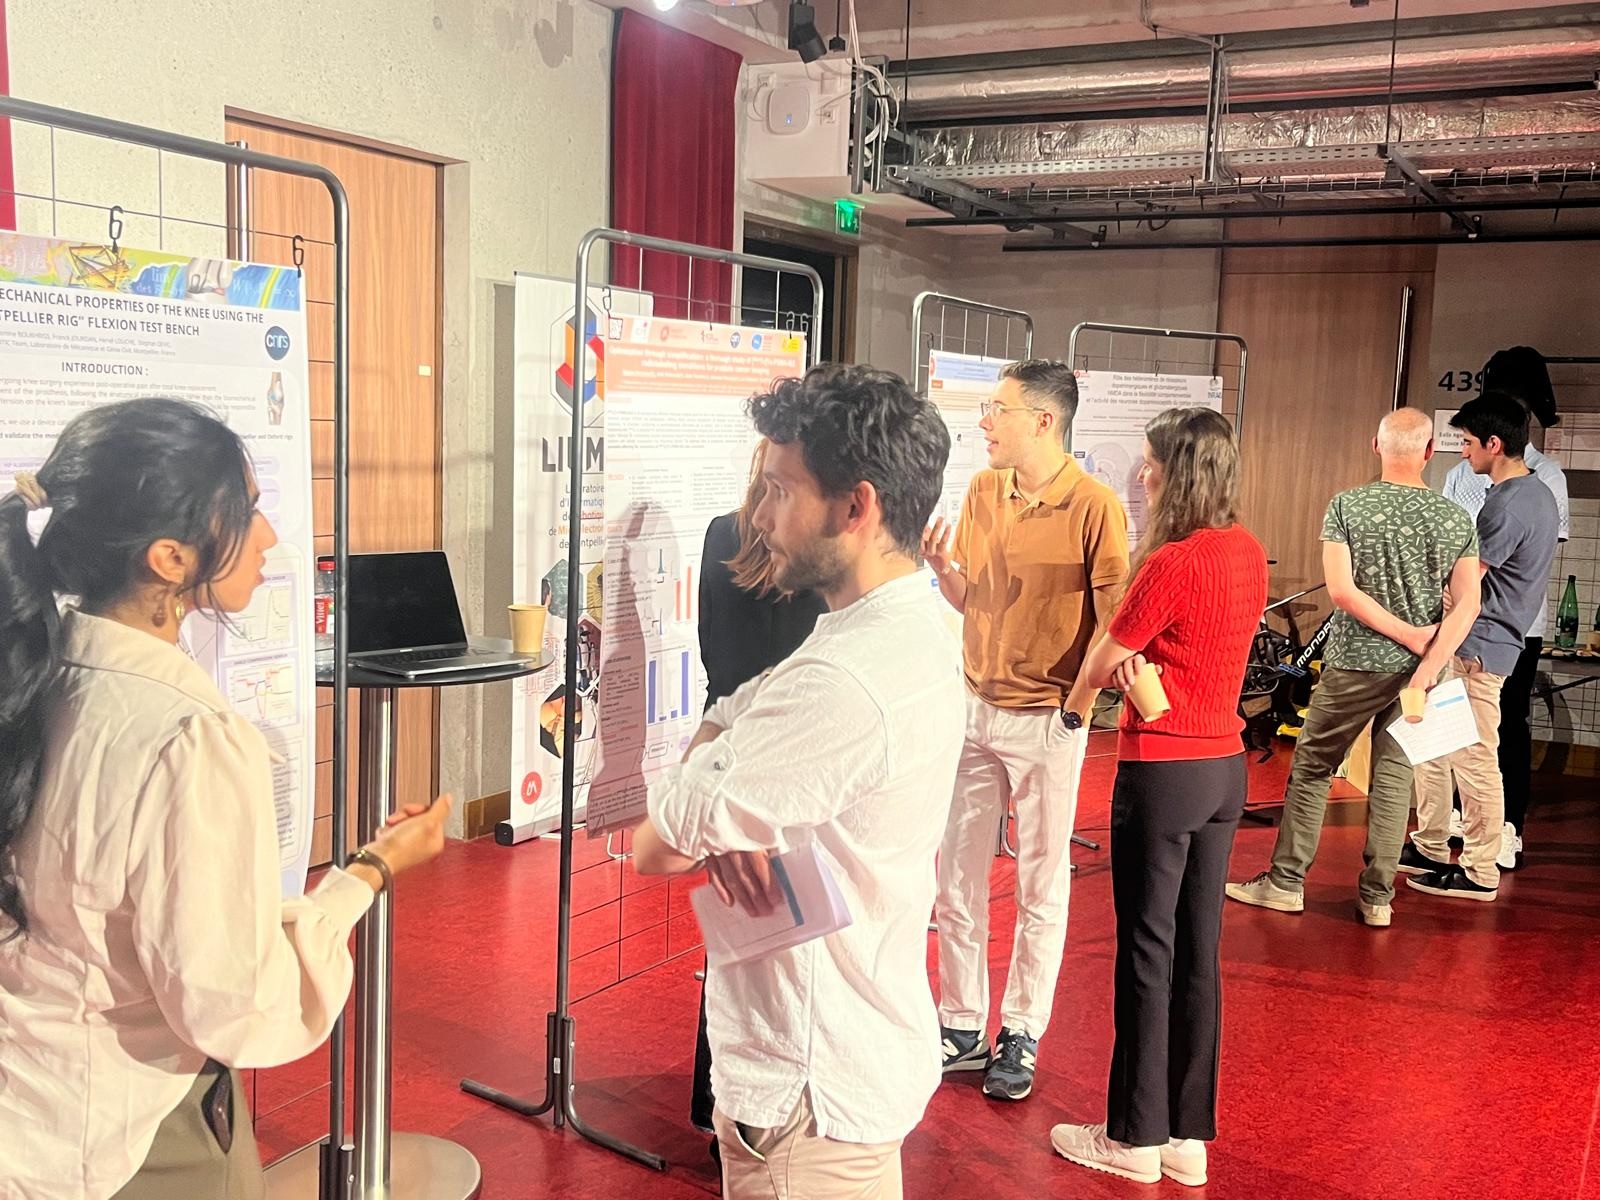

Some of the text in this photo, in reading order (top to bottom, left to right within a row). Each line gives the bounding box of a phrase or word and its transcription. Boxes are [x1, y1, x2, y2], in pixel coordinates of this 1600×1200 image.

[76, 295, 144, 313] PROPERTIES
[146, 302, 160, 314] OF
[163, 304, 182, 317] THE
[185, 306, 210, 319] KNEE
[212, 309, 243, 322] USING
[246, 312, 264, 324] THE
[88, 316, 137, 331] FLEXION
[140, 321, 162, 333] TEST
[166, 323, 200, 336] BENCH
[61, 361, 143, 376] INTRODUCTION
